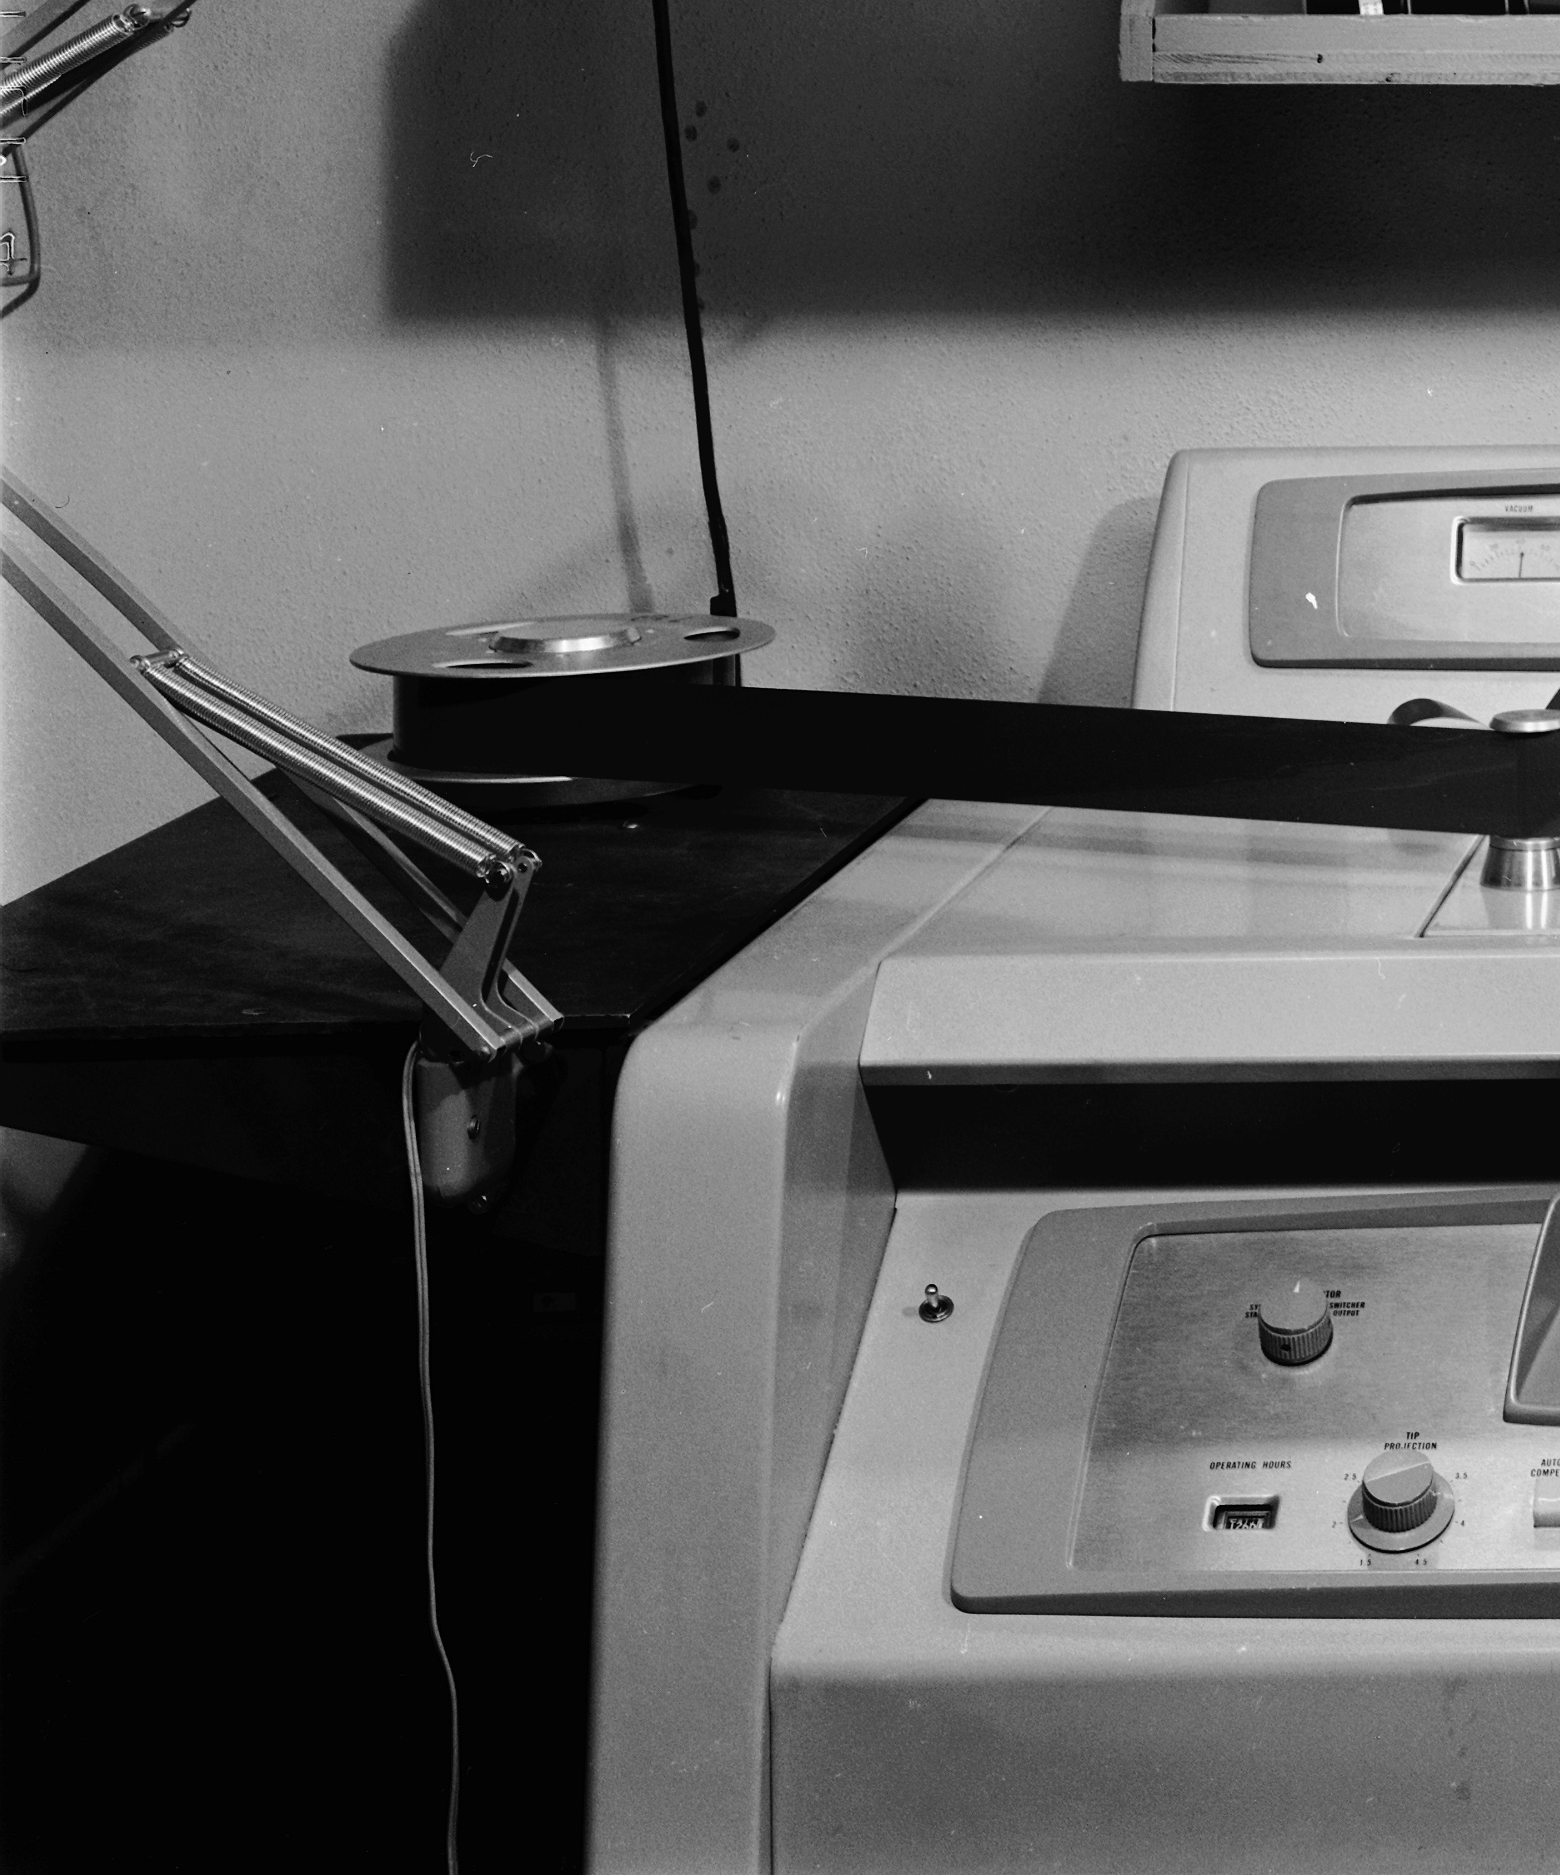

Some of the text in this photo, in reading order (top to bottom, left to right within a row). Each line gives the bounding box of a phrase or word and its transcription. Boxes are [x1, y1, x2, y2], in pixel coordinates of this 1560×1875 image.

[1505, 505, 1533, 513] VACUUM
[1329, 1301, 1365, 1309] SWITCHER
[1406, 1431, 1420, 1440] TIP
[1384, 1442, 1437, 1451] PROJECTION
[1209, 1460, 1292, 1470] OPERATING HOURS
